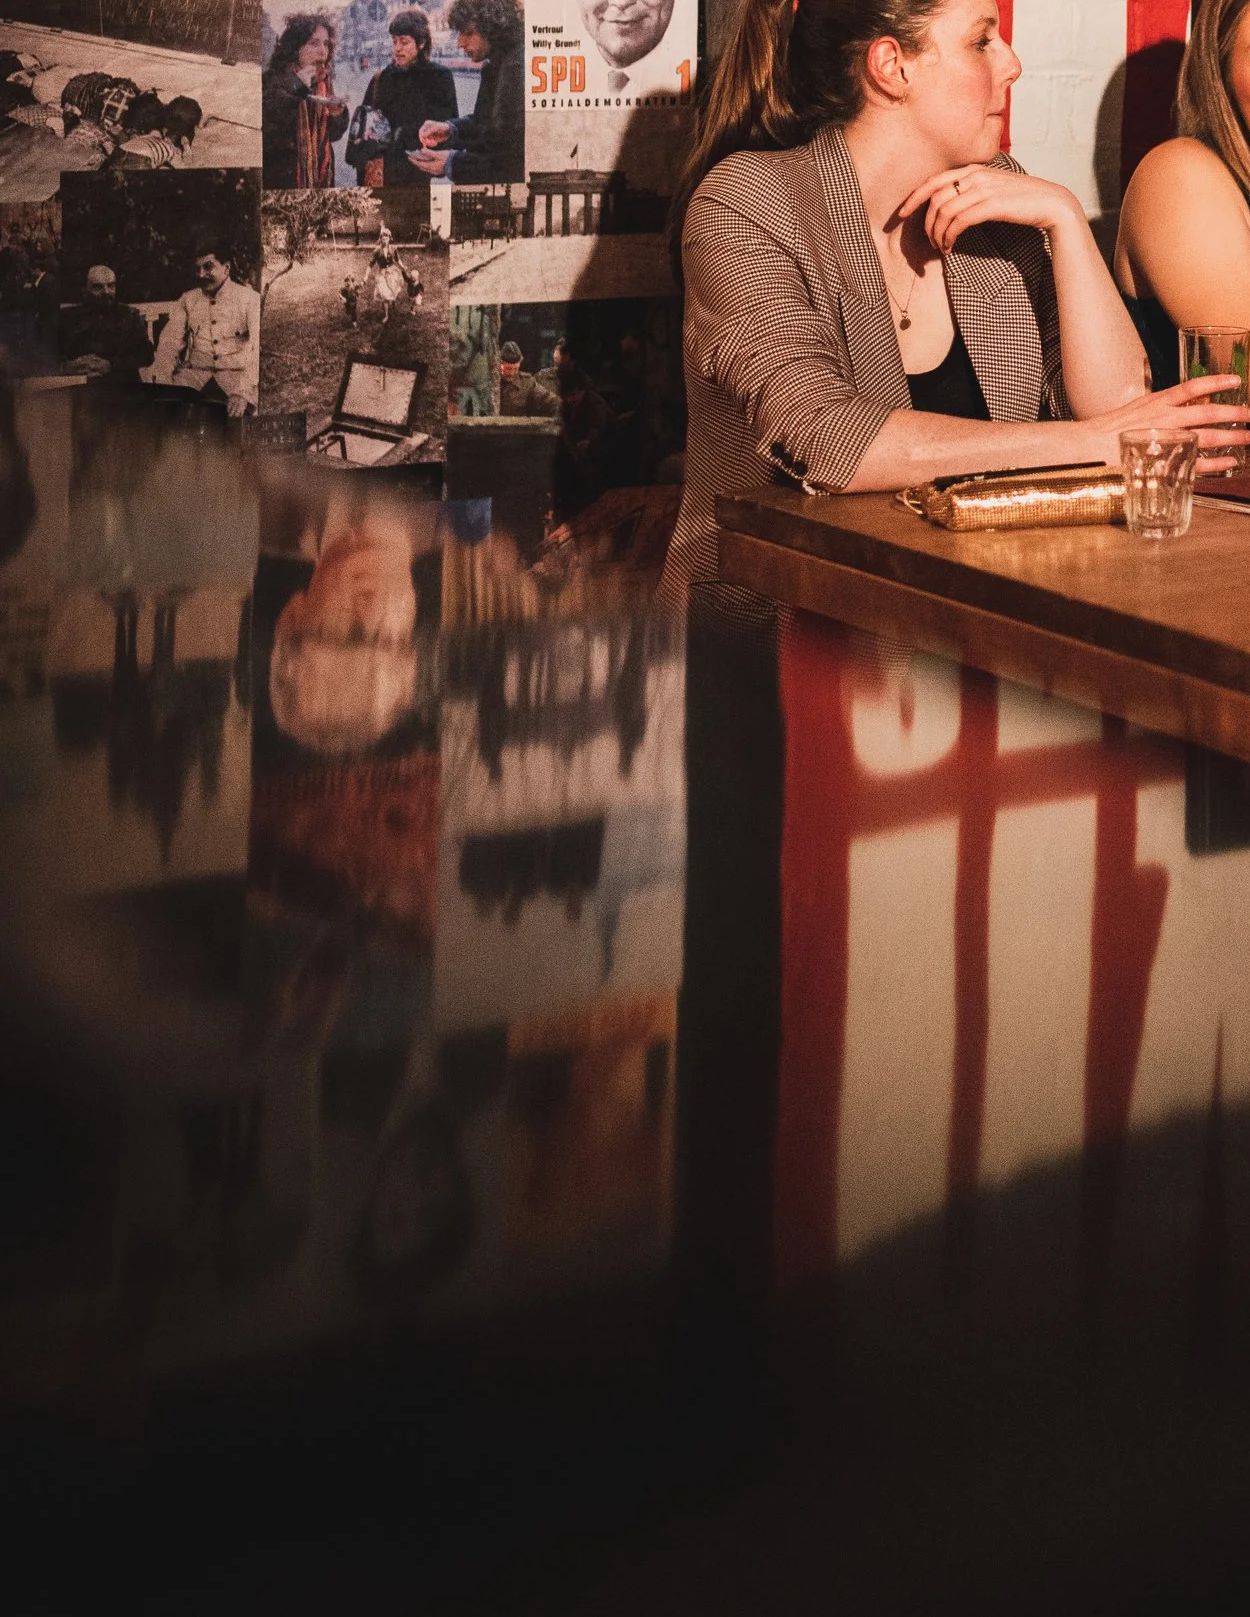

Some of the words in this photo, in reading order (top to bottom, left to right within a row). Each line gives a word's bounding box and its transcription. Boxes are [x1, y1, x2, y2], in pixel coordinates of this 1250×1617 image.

[532, 40, 552, 49] Willy
[555, 39, 580, 50] Brandt
[532, 56, 586, 93] SPD
[676, 59, 690, 105] 1
[532, 97, 677, 108] SOZIALDEMOKRATEN
